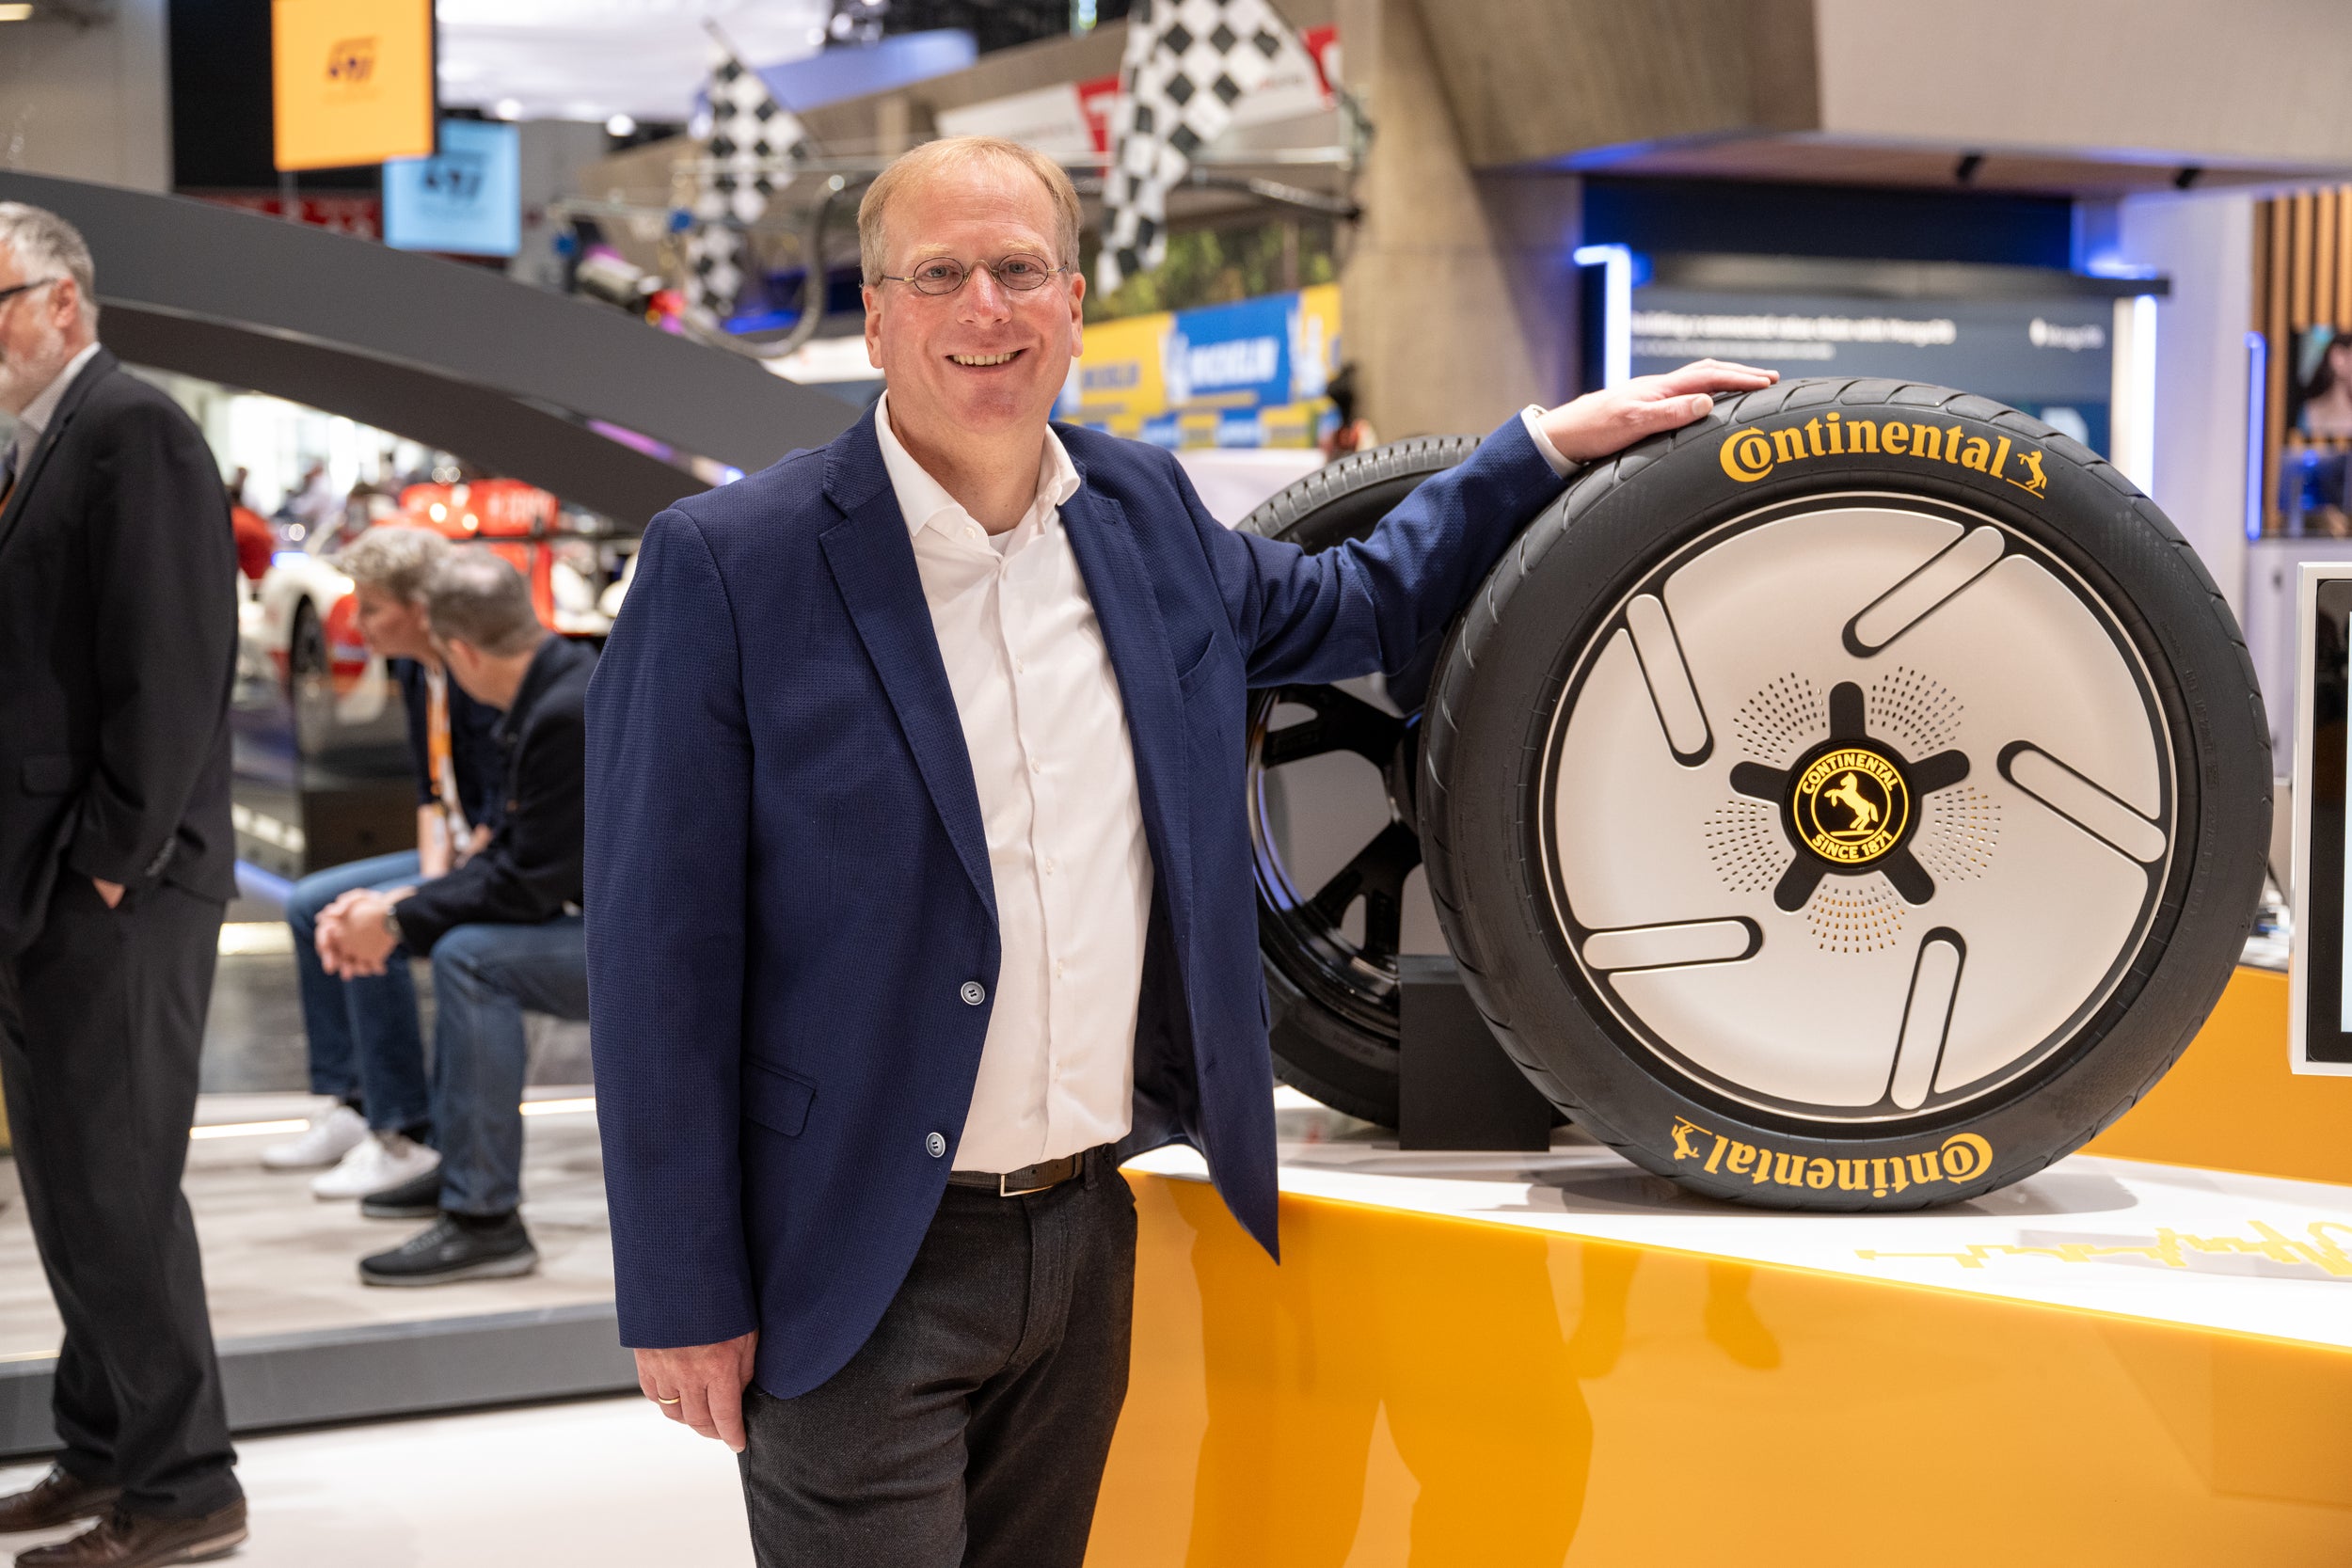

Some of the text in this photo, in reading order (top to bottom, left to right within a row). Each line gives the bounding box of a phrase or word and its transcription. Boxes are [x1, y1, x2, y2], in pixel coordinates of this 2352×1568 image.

[1719, 412, 2011, 483] Continental
[1802, 753, 1899, 794] CONTINENTAL
[1812, 830, 1893, 859] SINCE 1871
[1704, 1132, 1994, 1197] Continental
